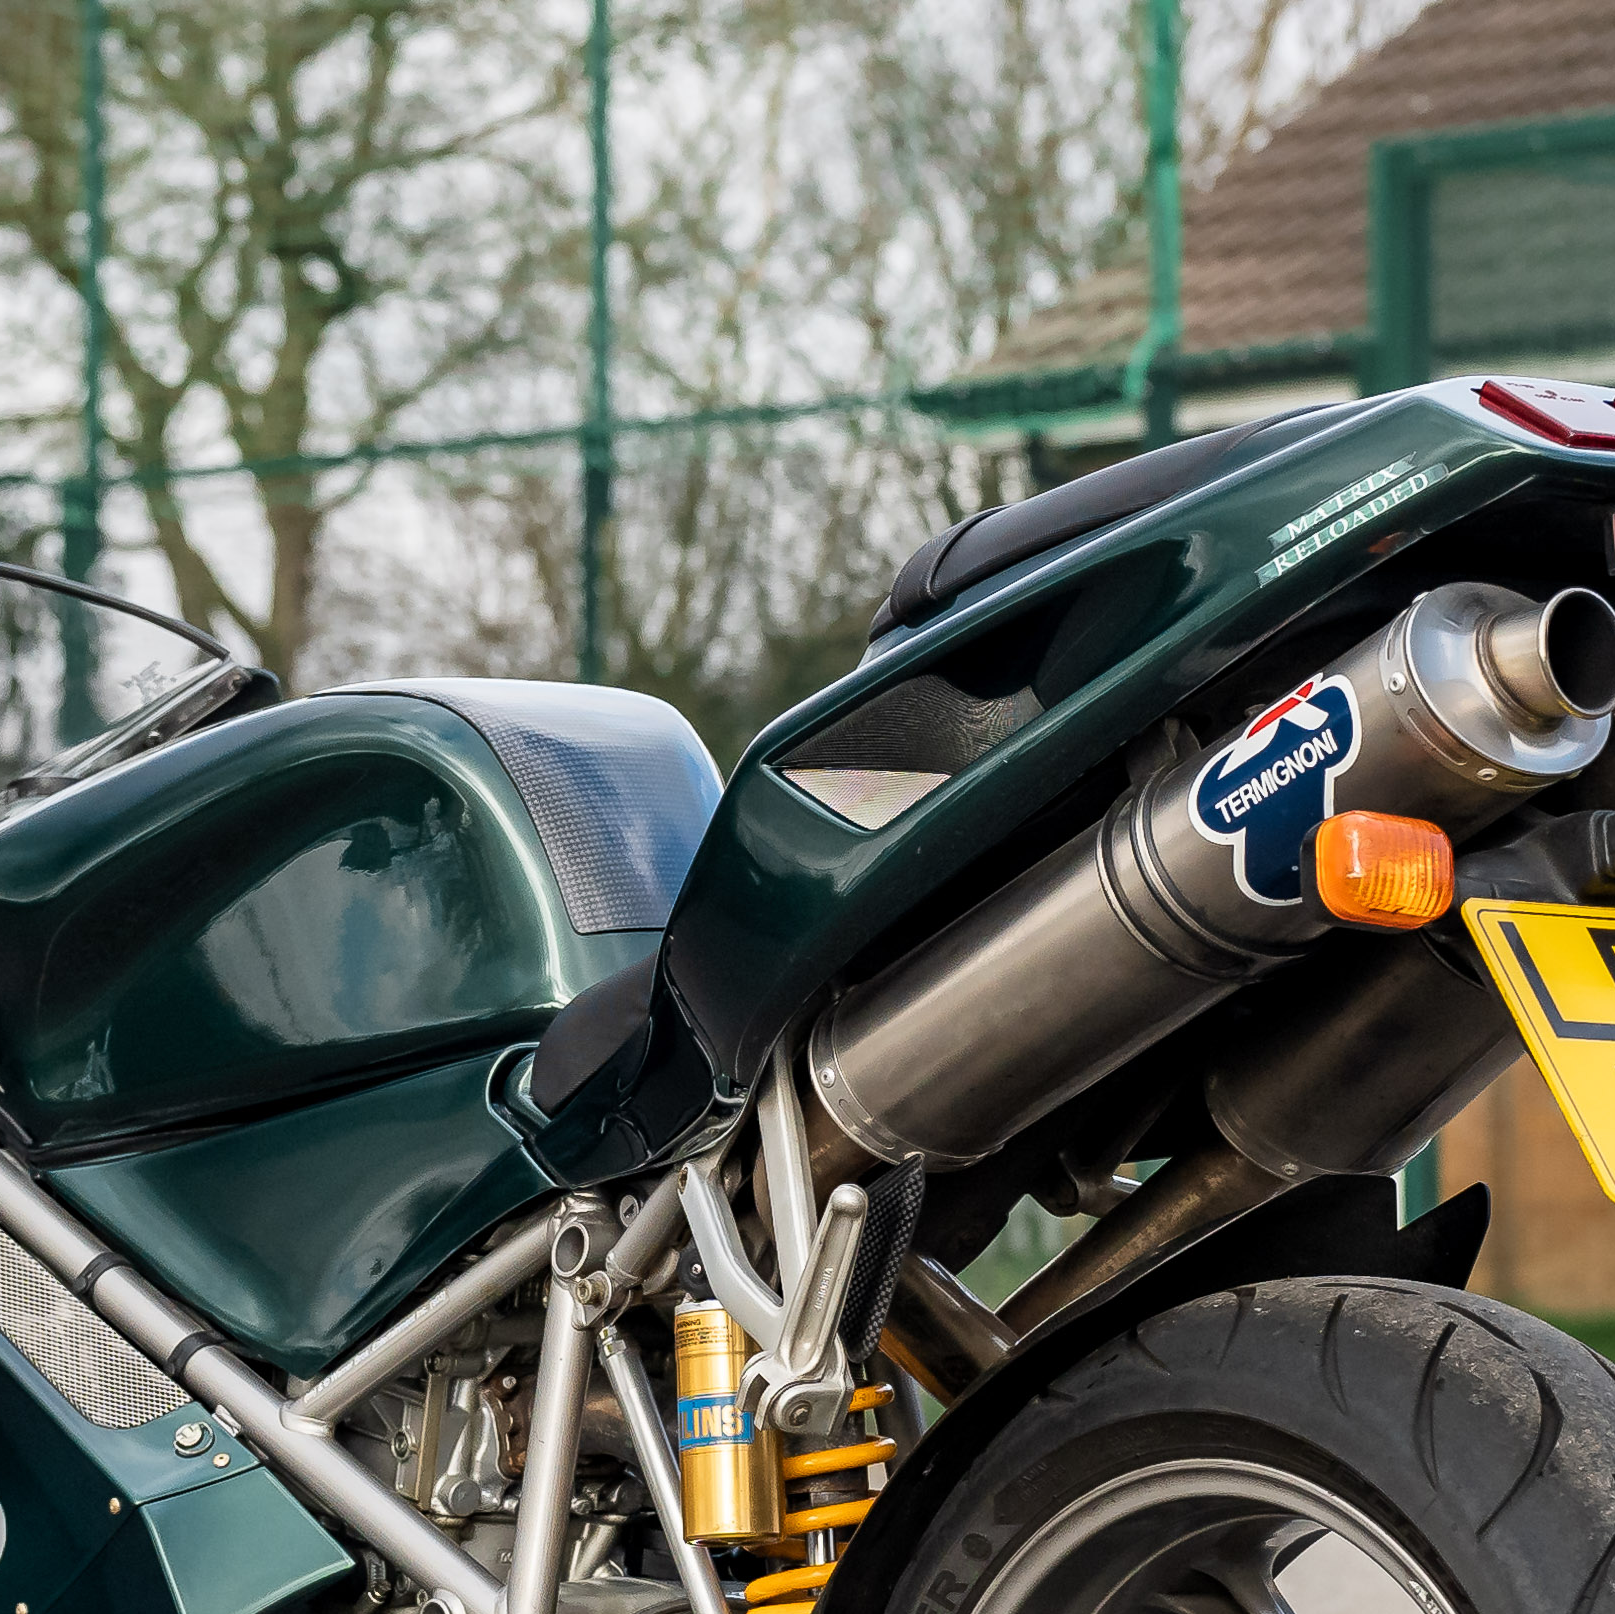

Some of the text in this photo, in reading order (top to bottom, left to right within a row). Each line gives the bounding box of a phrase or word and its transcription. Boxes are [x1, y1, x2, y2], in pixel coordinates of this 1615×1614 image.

[1272, 471, 1429, 577] RELOADED
[1284, 463, 1402, 541] MATRIX
[1214, 728, 1338, 824] TERMIGNONI
[681, 1404, 744, 1440] LINS
